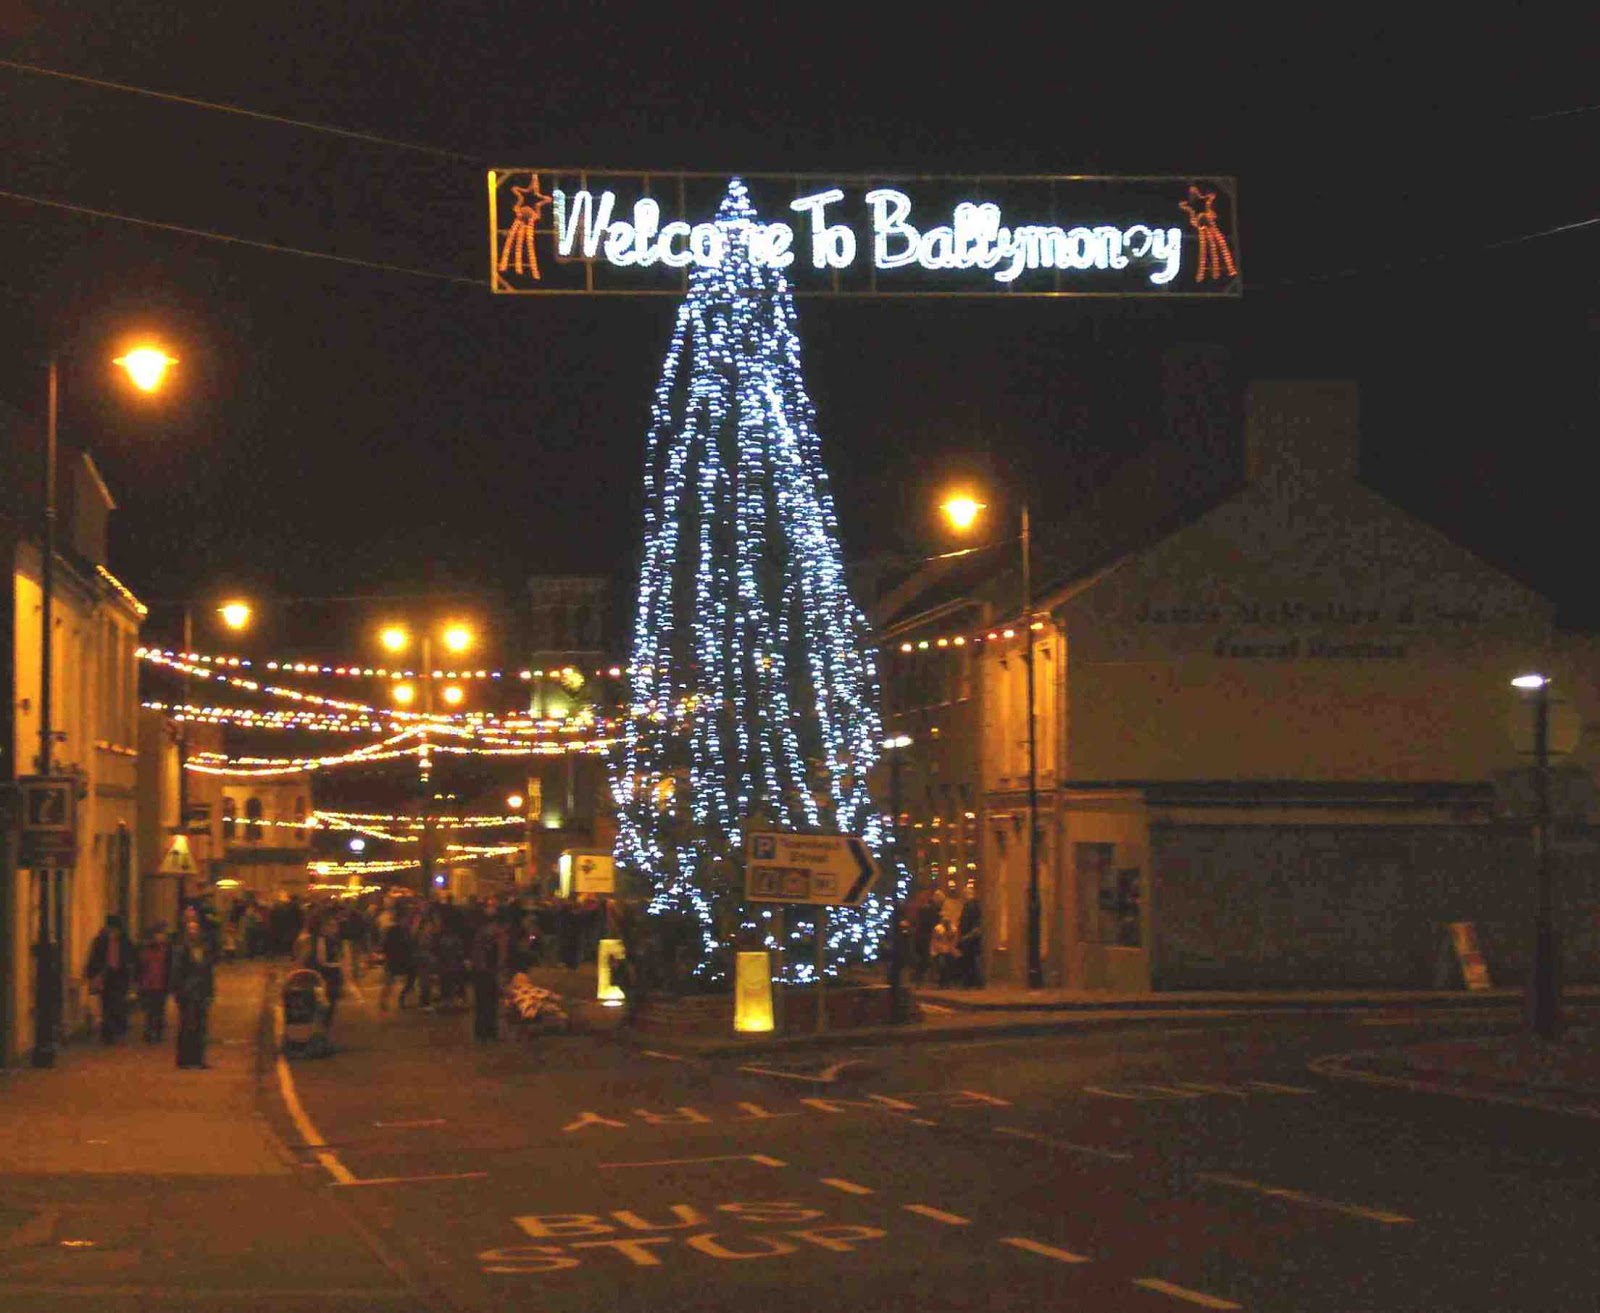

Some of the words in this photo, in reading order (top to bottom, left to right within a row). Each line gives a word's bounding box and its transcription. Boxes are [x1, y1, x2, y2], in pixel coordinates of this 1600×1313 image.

[553, 189, 795, 267] Welcome
[790, 189, 856, 269] To
[865, 188, 1182, 284] Ballymoney
[513, 1202, 825, 1238] BUS
[477, 1224, 888, 1273] STOP
